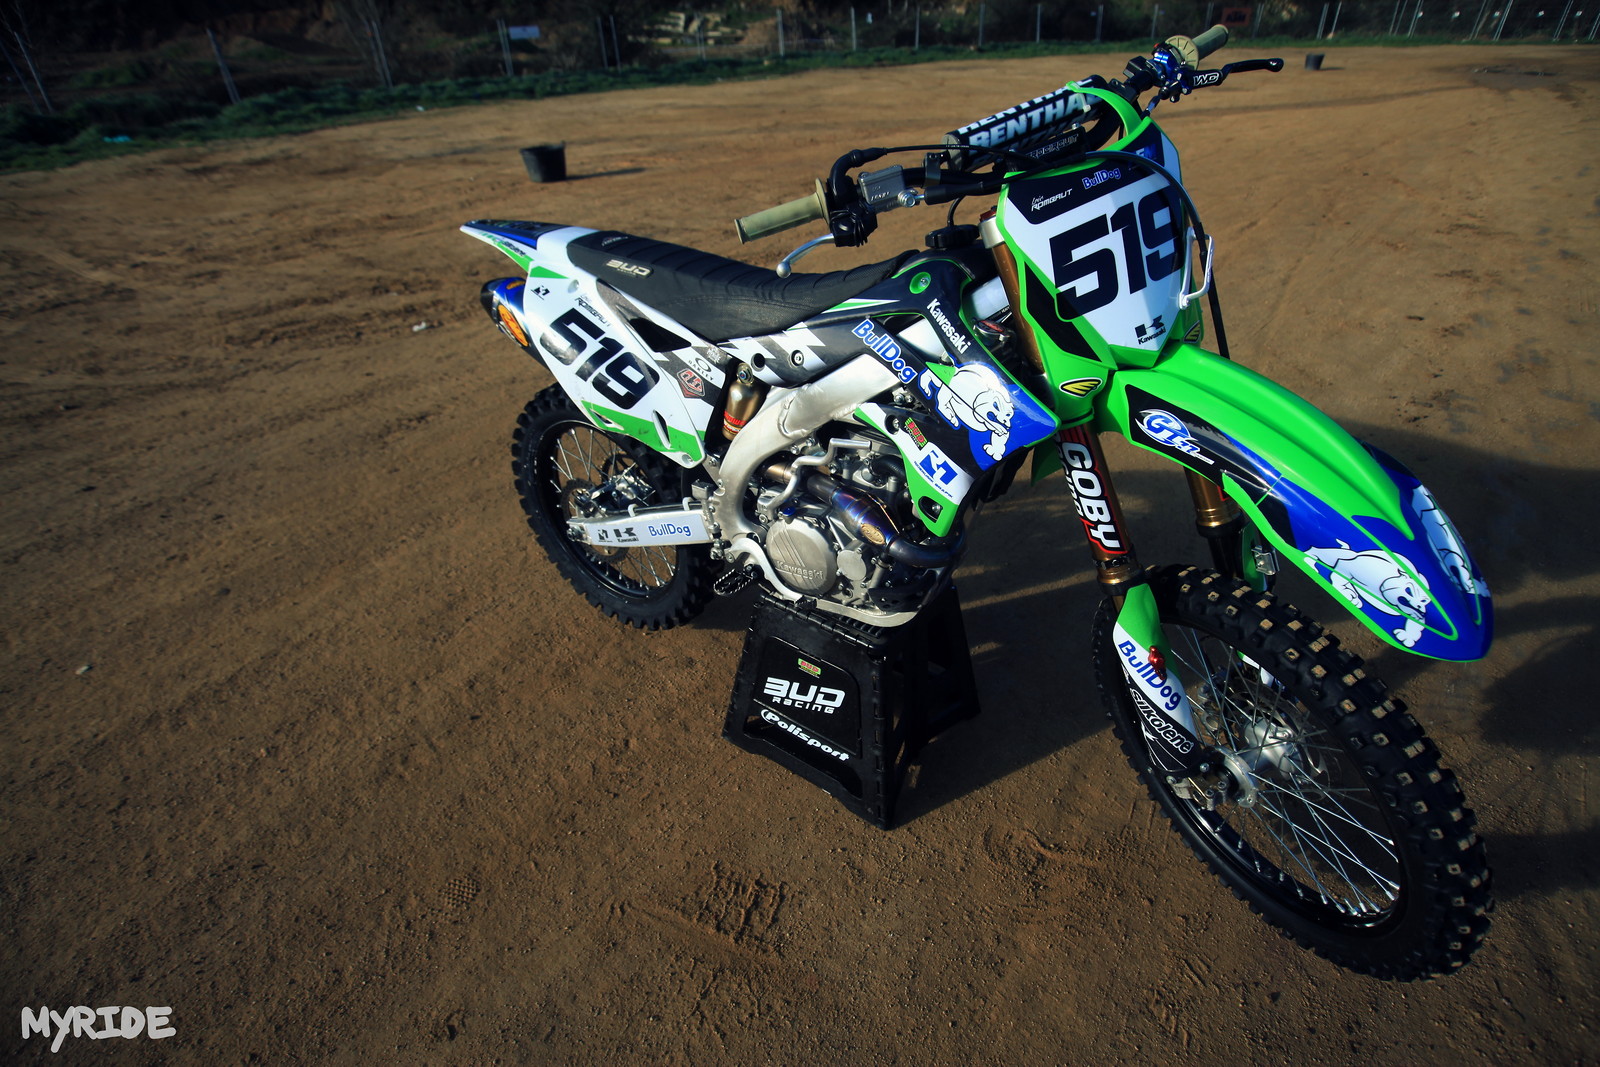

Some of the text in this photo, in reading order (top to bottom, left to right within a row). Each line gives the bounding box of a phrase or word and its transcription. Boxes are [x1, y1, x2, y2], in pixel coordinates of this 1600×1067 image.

[1082, 168, 1121, 189] BullDog
[1049, 189, 1184, 320] 519
[851, 318, 918, 384] BullDog
[927, 298, 972, 355] Kawasaki
[1138, 327, 1167, 345] Kawasaki
[540, 308, 660, 410] 519
[1062, 442, 1121, 548] GOBY
[648, 524, 691, 538] BullDog
[776, 560, 825, 580] Kawasaki
[763, 677, 846, 708] BUD
[1118, 640, 1181, 711] BullDog
[760, 708, 850, 761] Polisport
